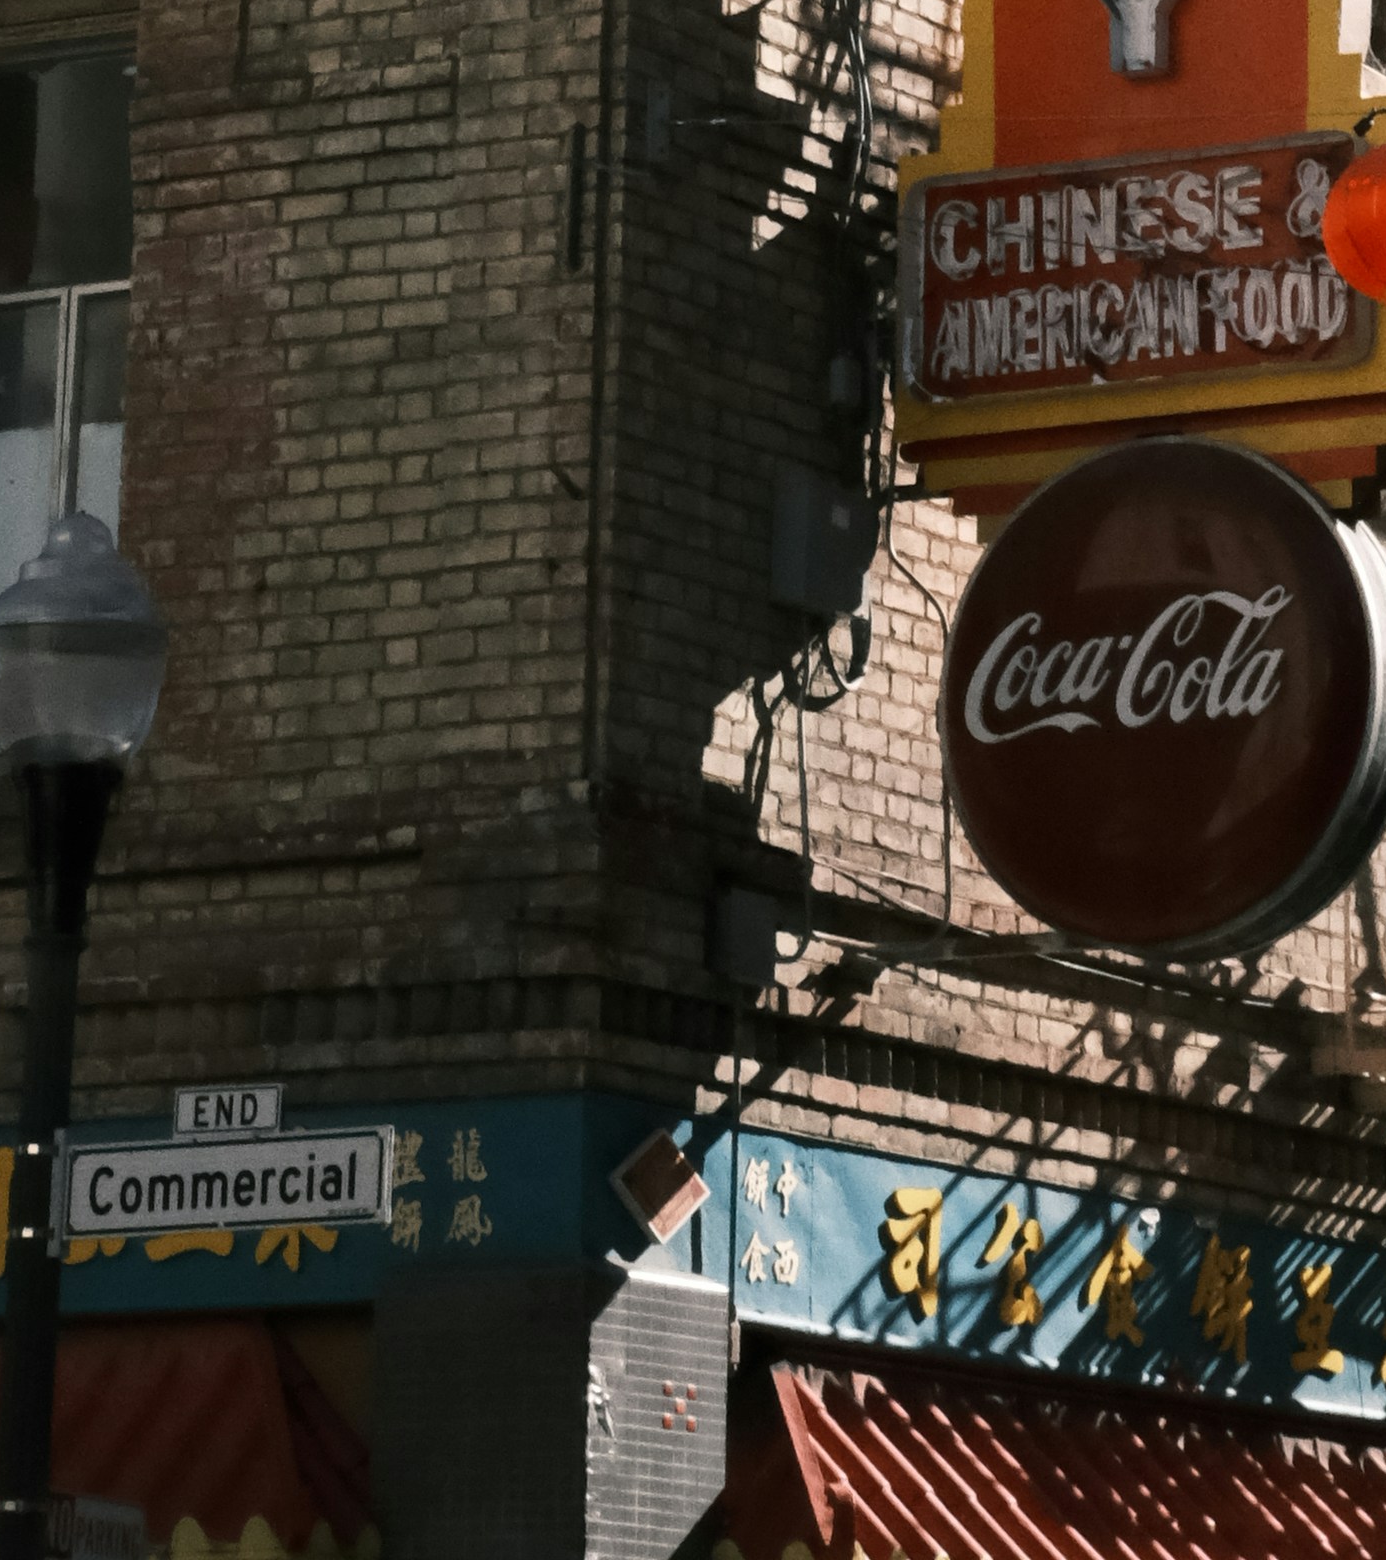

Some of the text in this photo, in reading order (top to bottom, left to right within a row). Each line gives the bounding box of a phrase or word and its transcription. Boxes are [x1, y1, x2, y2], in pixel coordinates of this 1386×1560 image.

[931, 165, 1264, 281] CHINESE
[931, 254, 1349, 382] AMERICAN FOOD
[963, 583, 1295, 745] Coca-Cola
[192, 1093, 259, 1129] END
[88, 1151, 359, 1216] Commercial
